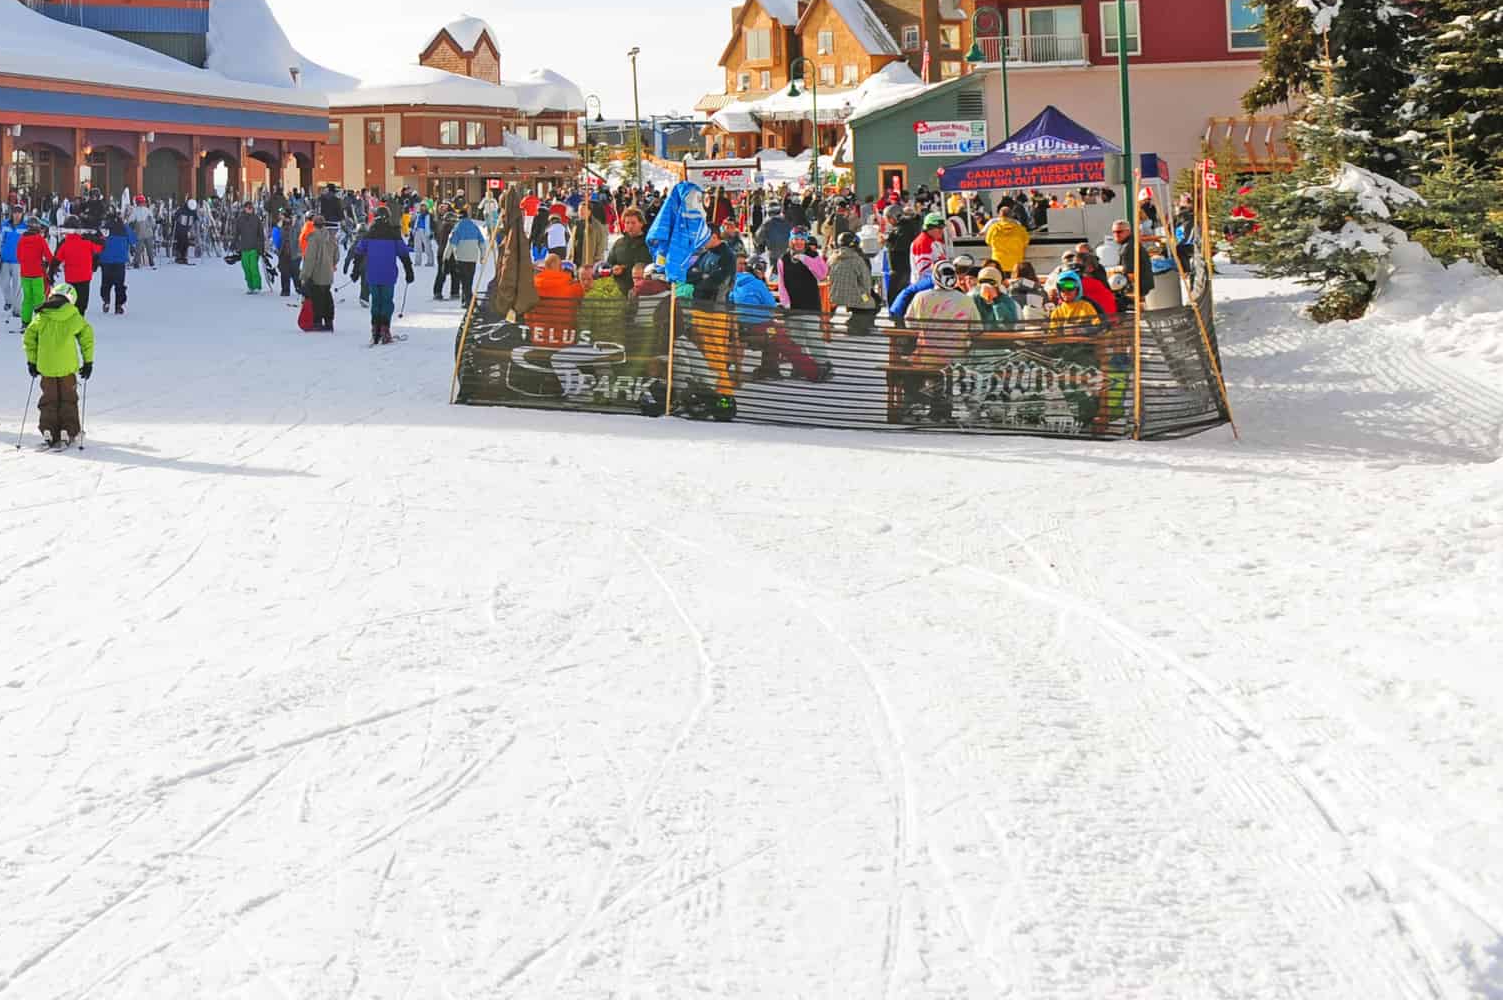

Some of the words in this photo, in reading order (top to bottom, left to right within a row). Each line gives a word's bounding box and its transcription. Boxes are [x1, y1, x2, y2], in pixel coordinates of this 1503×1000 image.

[966, 167, 1022, 180] CANADA'S
[1024, 163, 1076, 176] LARGEST
[1079, 161, 1106, 173] TOTA
[1040, 171, 1082, 185] RESORT
[518, 325, 593, 345] TELUS
